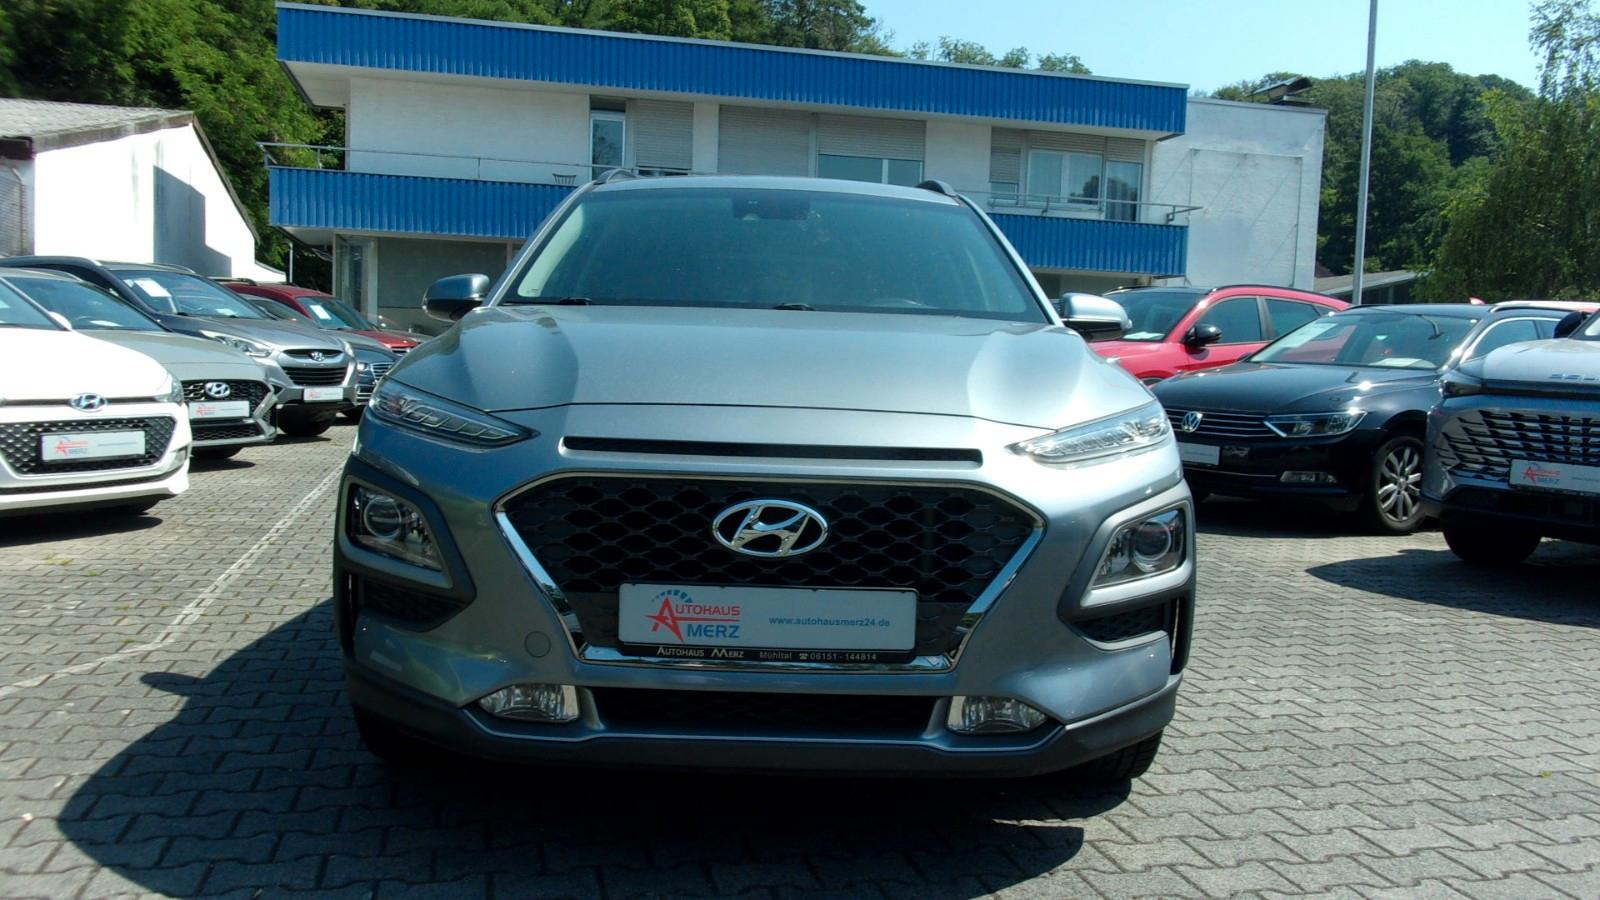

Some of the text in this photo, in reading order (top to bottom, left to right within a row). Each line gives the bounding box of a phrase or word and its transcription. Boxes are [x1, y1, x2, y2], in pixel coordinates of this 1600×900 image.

[650, 597, 741, 640] AUTOHAUS
[768, 616, 891, 628] www.autohausmerz24.de
[686, 623, 741, 639] MERZ
[656, 646, 705, 657] AUTOHAUS
[711, 647, 745, 658] MERZ
[759, 650, 792, 660] Mühltal
